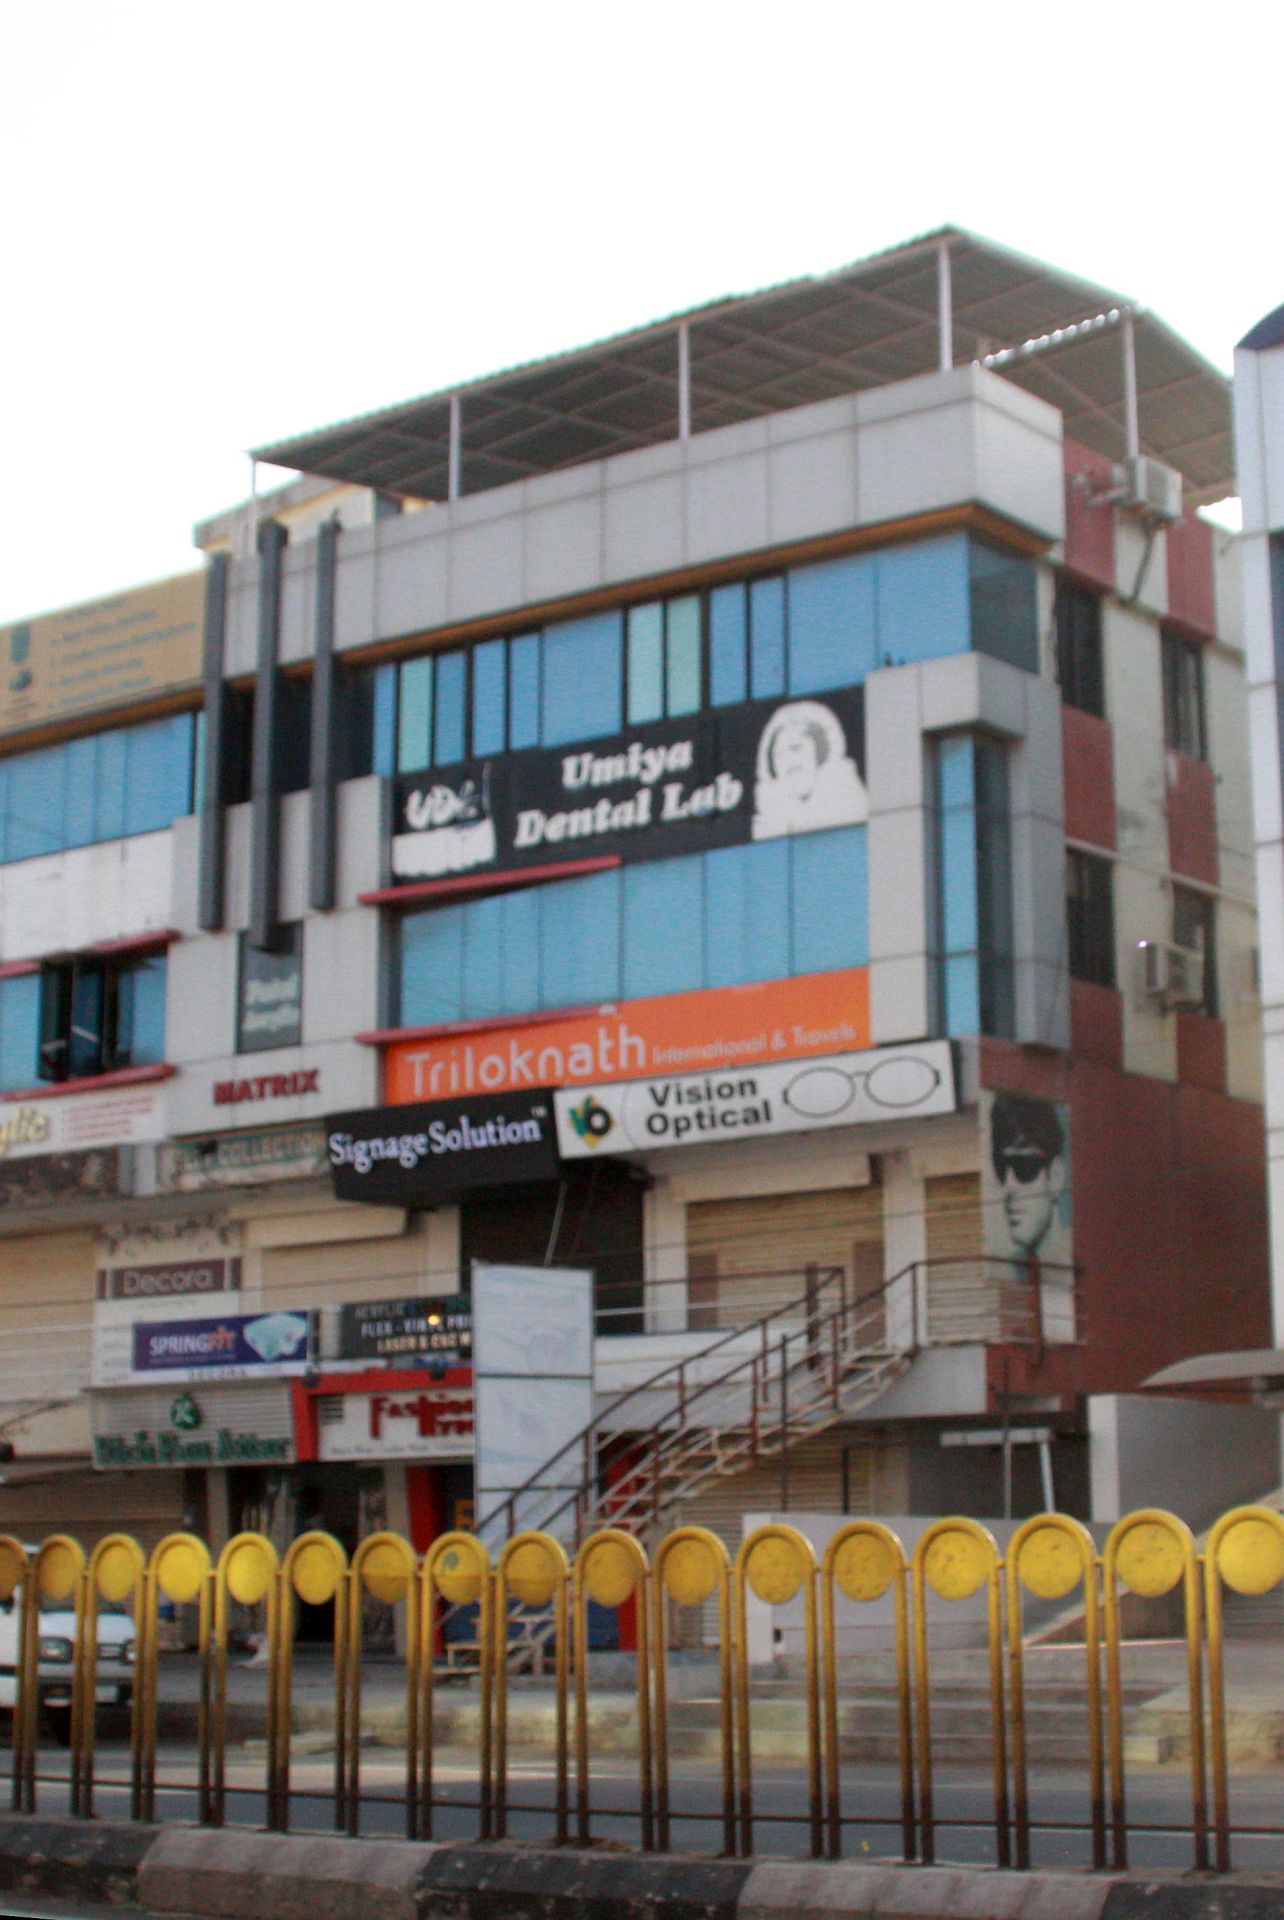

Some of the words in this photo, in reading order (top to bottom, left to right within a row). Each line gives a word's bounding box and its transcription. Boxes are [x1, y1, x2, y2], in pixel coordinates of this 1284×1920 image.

[560, 739, 694, 791] Umiya
[512, 786, 653, 850] Dental
[660, 771, 744, 820] Lab
[406, 1024, 646, 1096] Triloknath
[653, 1034, 768, 1066] International
[770, 1028, 786, 1051] &
[213, 1069, 320, 1106] MATRIX
[648, 1078, 758, 1108] Vision
[646, 1100, 773, 1138] Optical
[329, 1131, 428, 1174] Signage
[428, 1115, 543, 1154] Solution
[123, 1268, 215, 1294] Decora
